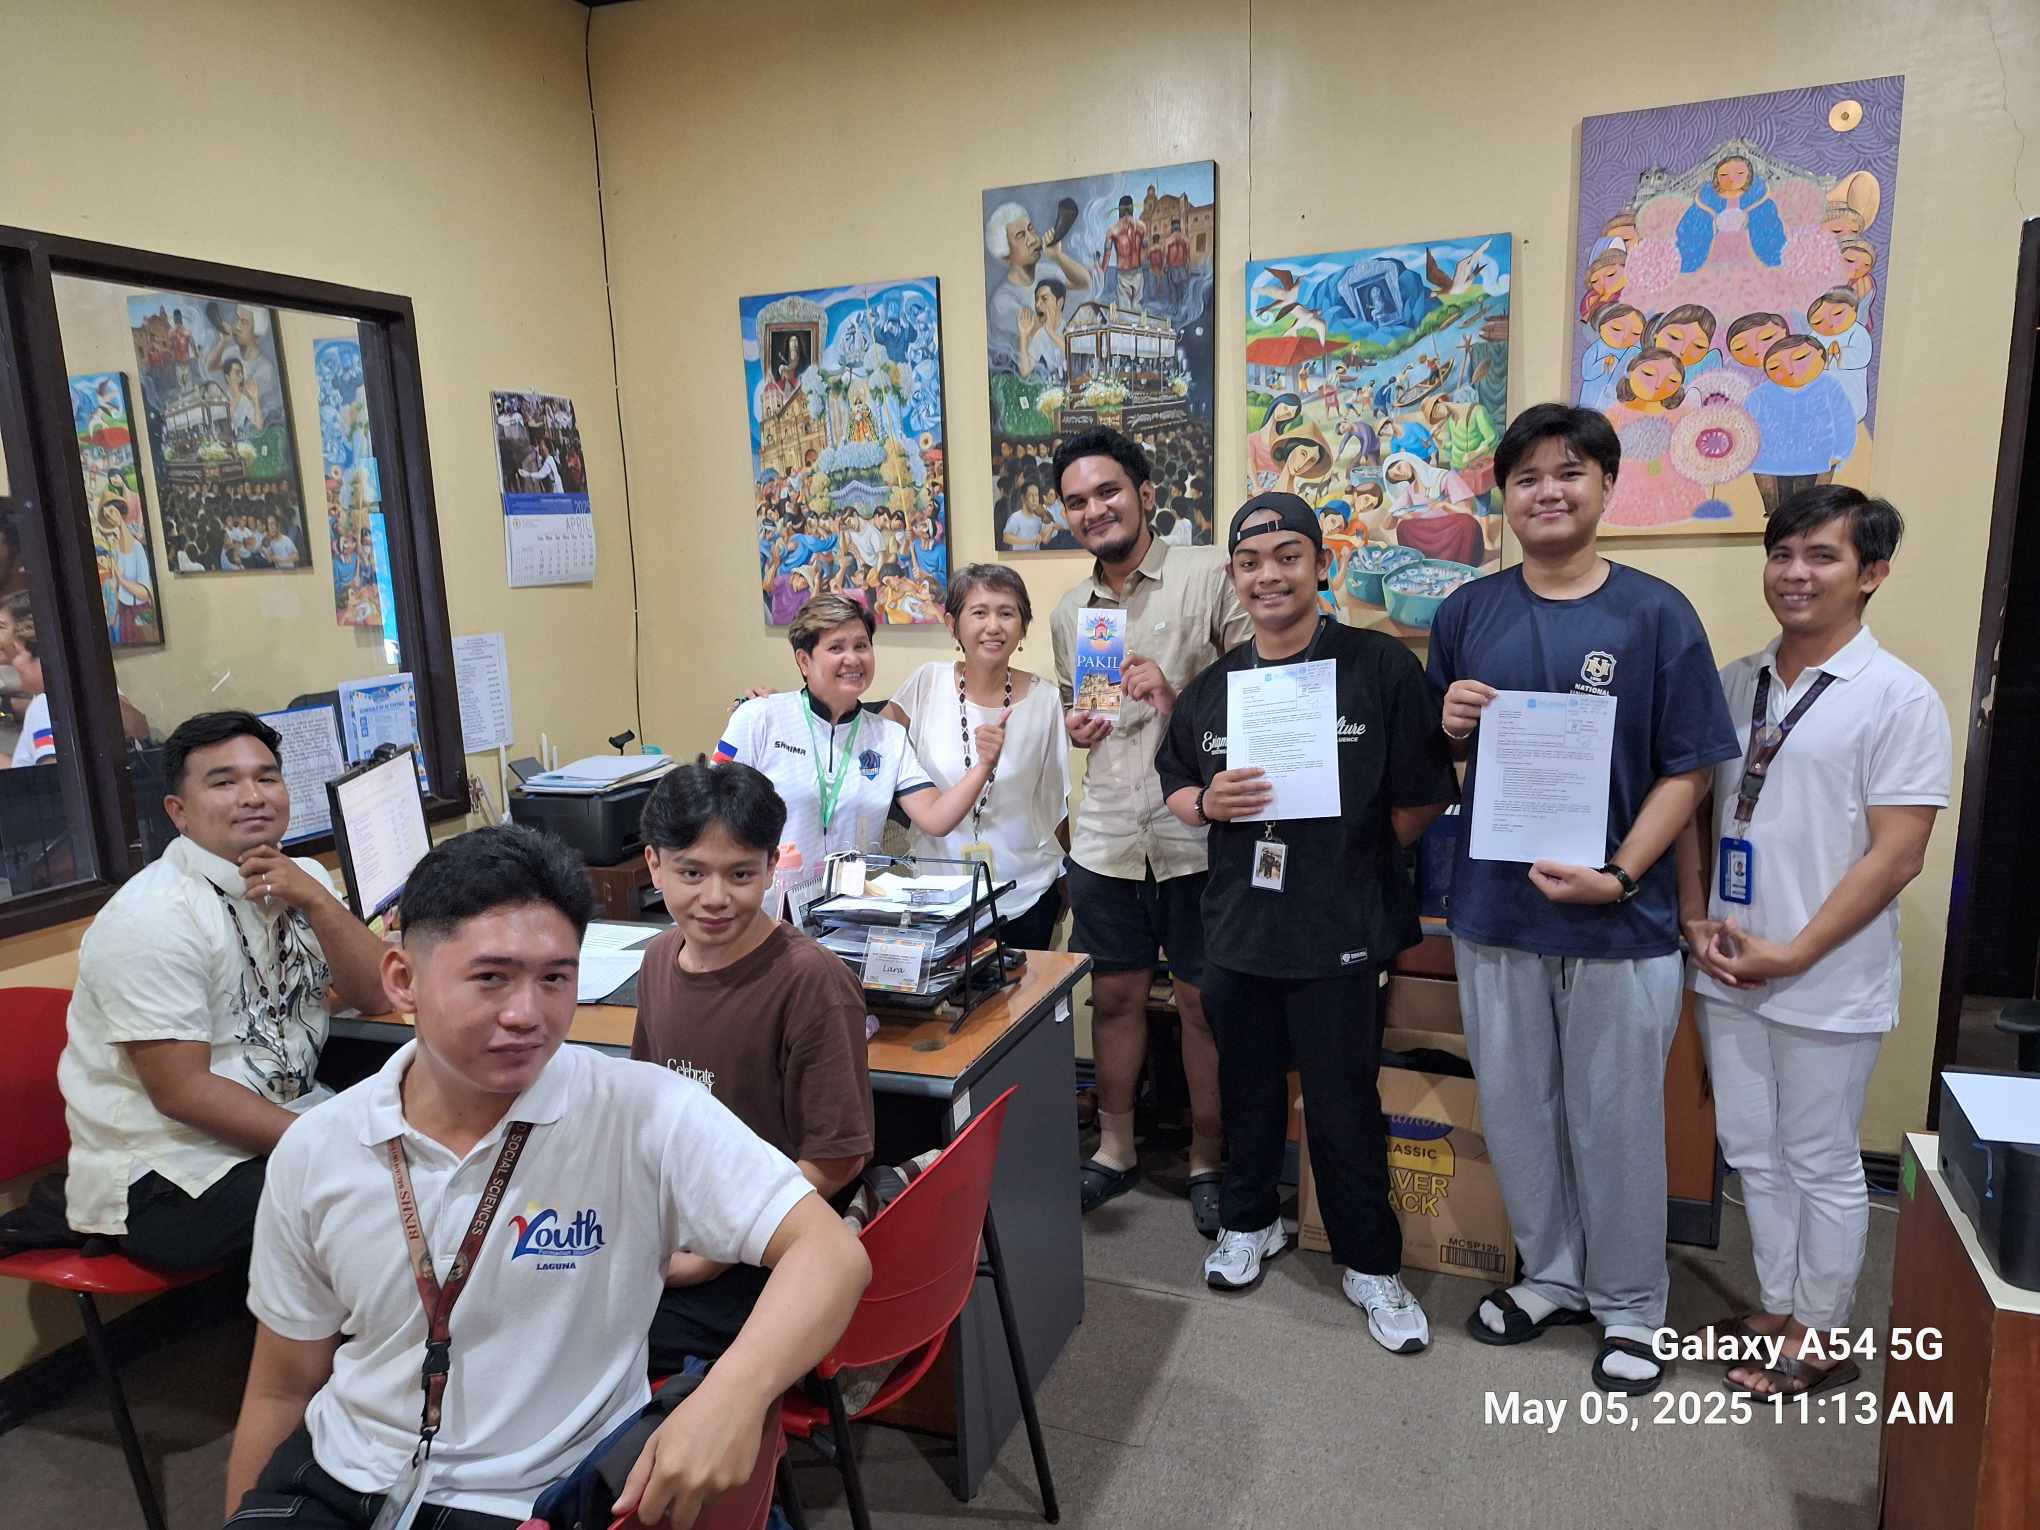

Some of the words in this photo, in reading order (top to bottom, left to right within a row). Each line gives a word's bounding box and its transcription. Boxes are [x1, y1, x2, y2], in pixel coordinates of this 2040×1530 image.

[1077, 655, 1121, 669] PAKIL
[1574, 683, 1610, 697] NATIONAL
[667, 1058, 715, 1083] Celebrate
[496, 1133, 523, 1173] SOCIAL
[471, 1179, 504, 1235] SCIENCES
[1388, 1189, 1440, 1217] ACK
[507, 1208, 606, 1260] Youth
[536, 1262, 576, 1271] LAGUNA
